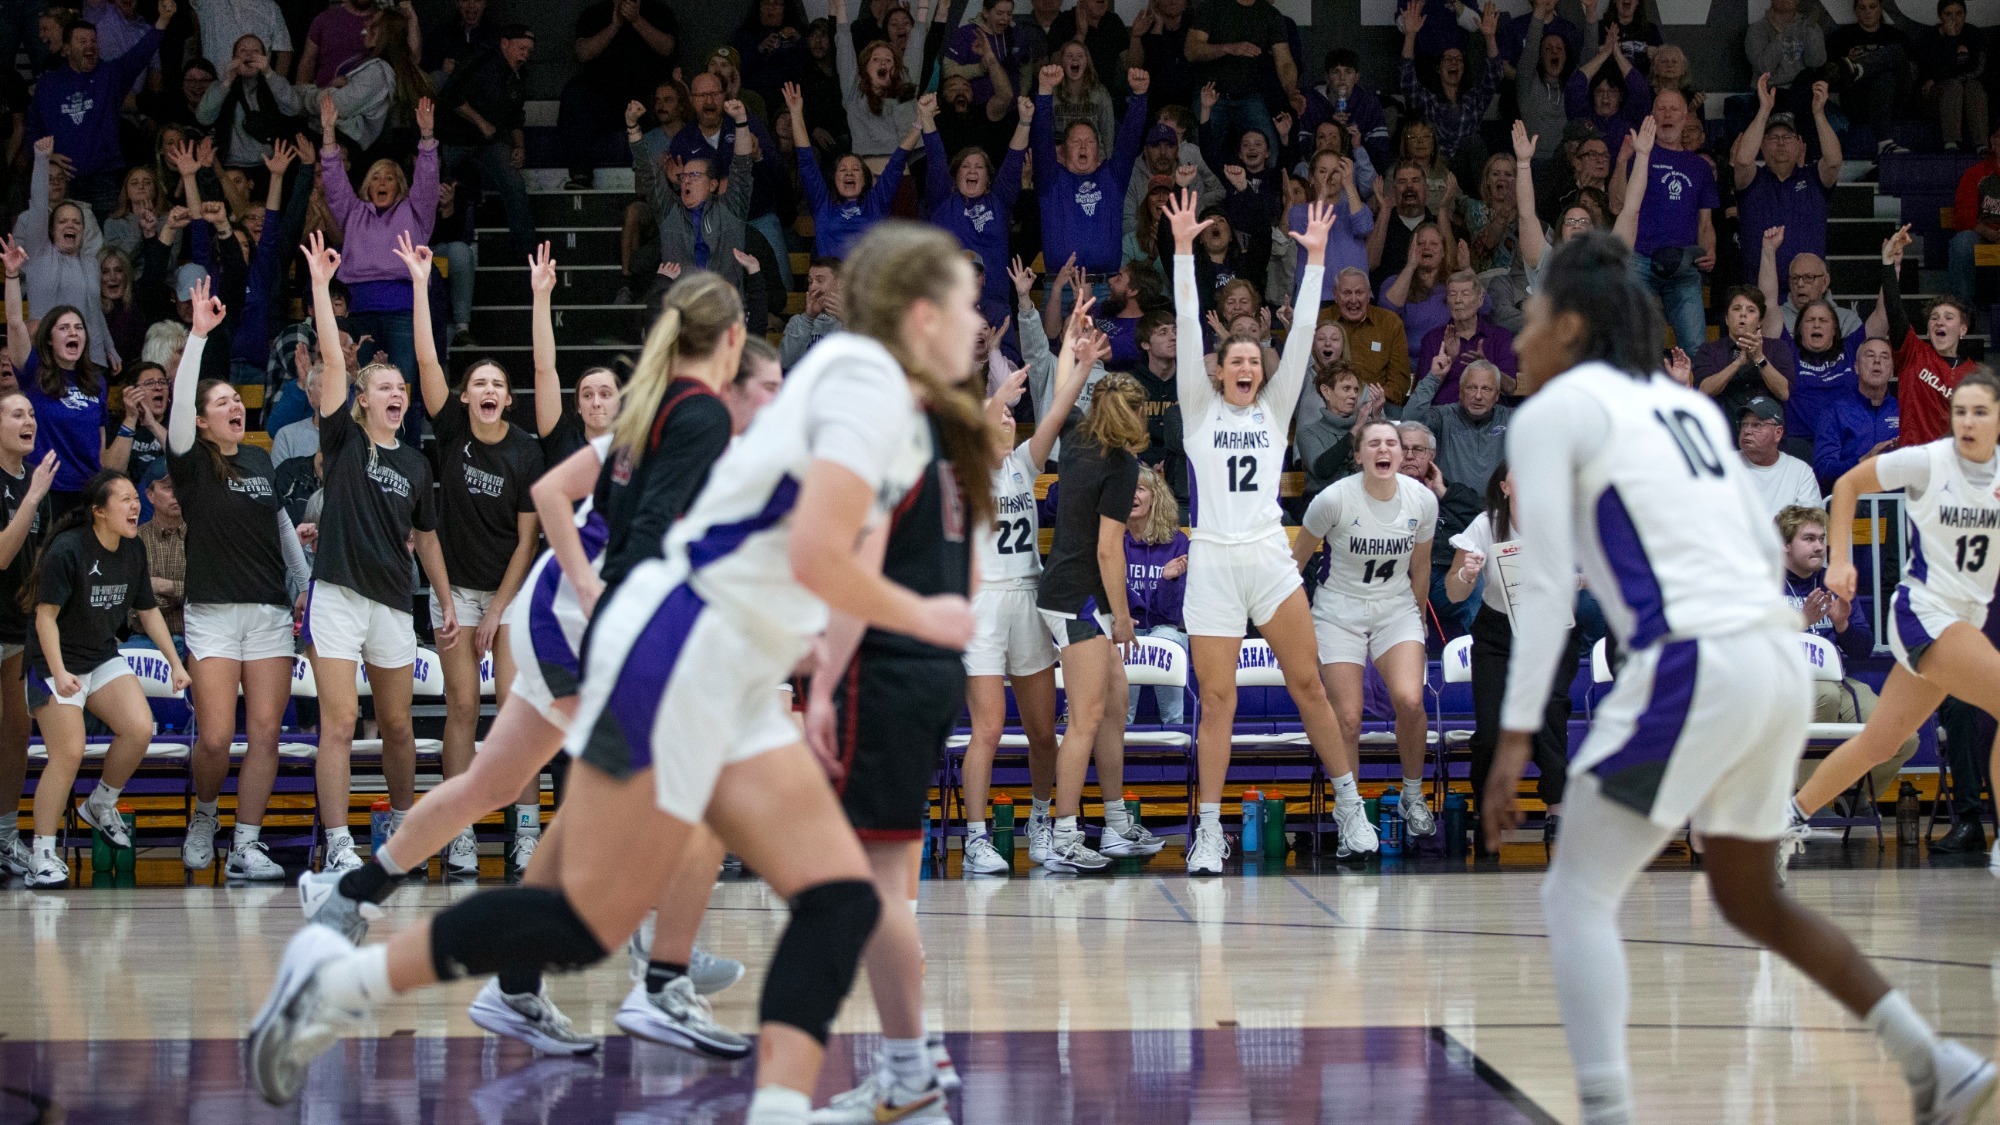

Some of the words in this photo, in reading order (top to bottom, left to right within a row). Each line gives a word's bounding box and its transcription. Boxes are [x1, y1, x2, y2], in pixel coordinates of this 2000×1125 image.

[573, 195, 582, 210] N
[567, 232, 576, 248] M
[564, 271, 572, 287] L
[555, 310, 564, 327] K
[1213, 430, 1270, 450] WARHAWKS
[1654, 408, 1726, 479] 10
[1226, 455, 1259, 493] 12
[1938, 504, 2000, 530] WARHAW
[993, 517, 1034, 555] 22
[1350, 534, 1416, 556] WARHAWKS
[1955, 534, 1991, 573] 13
[1362, 559, 1399, 585] 14
[127, 656, 170, 684] HAWKS
[1123, 644, 1173, 672] HAWKS
